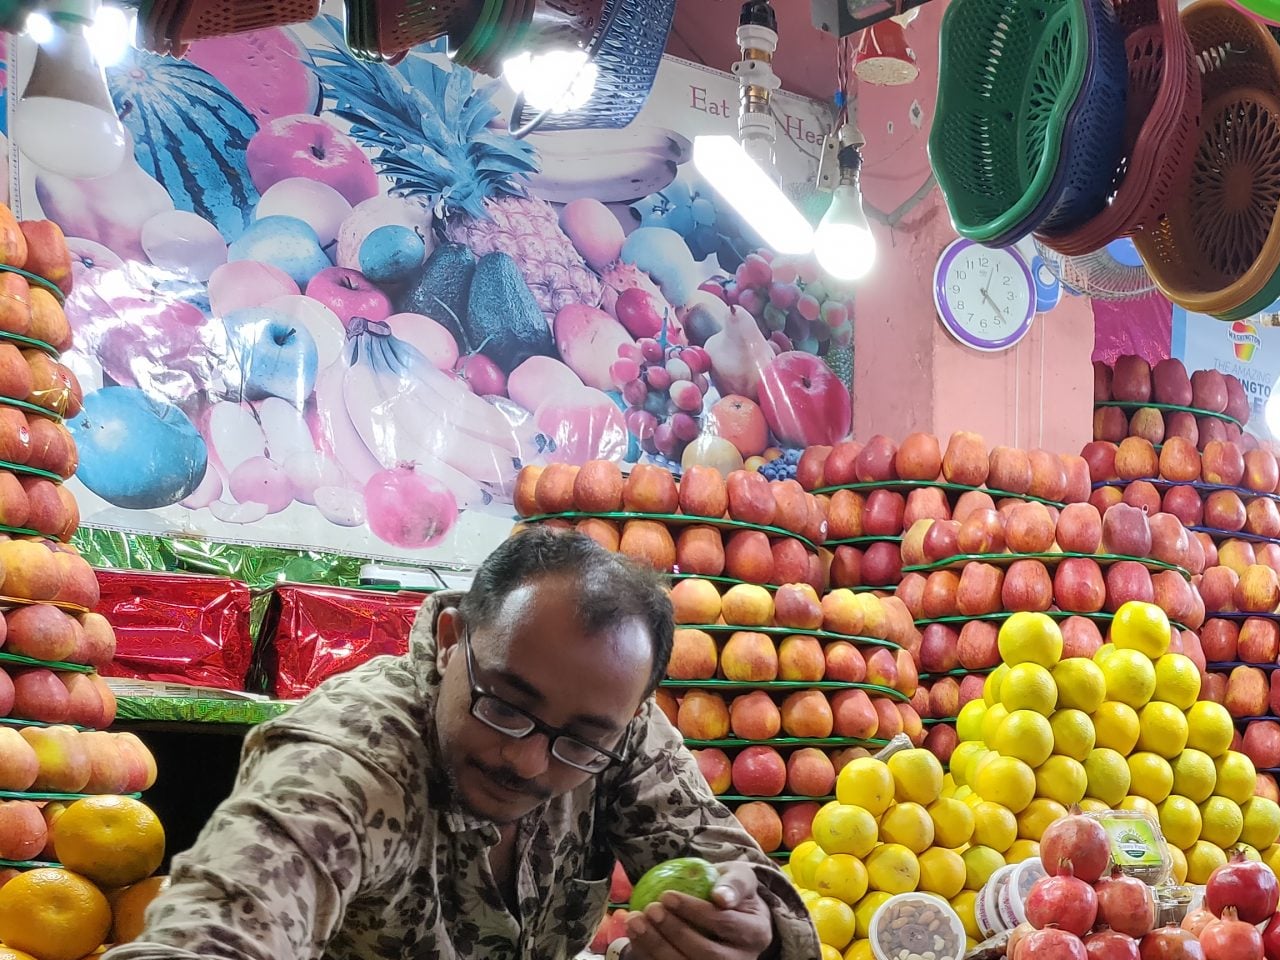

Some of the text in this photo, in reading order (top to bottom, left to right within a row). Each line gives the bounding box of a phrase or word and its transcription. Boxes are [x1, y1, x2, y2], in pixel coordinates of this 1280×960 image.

[689, 85, 730, 118] Eat
[966, 260, 974, 270] 11
[978, 257, 989, 268] 12
[956, 270, 967, 280] 10
[1002, 276, 1011, 286] 2
[952, 285, 961, 295] 9
[1006, 291, 1015, 301] 3
[957, 301, 965, 310] 8
[1003, 306, 1010, 315] 4
[967, 313, 975, 322] 7
[993, 316, 1001, 325] 5
[979, 319, 988, 328] 6
[1228, 330, 1261, 348] WASHINGTON
[1214, 358, 1272, 383] THE AMAZING
